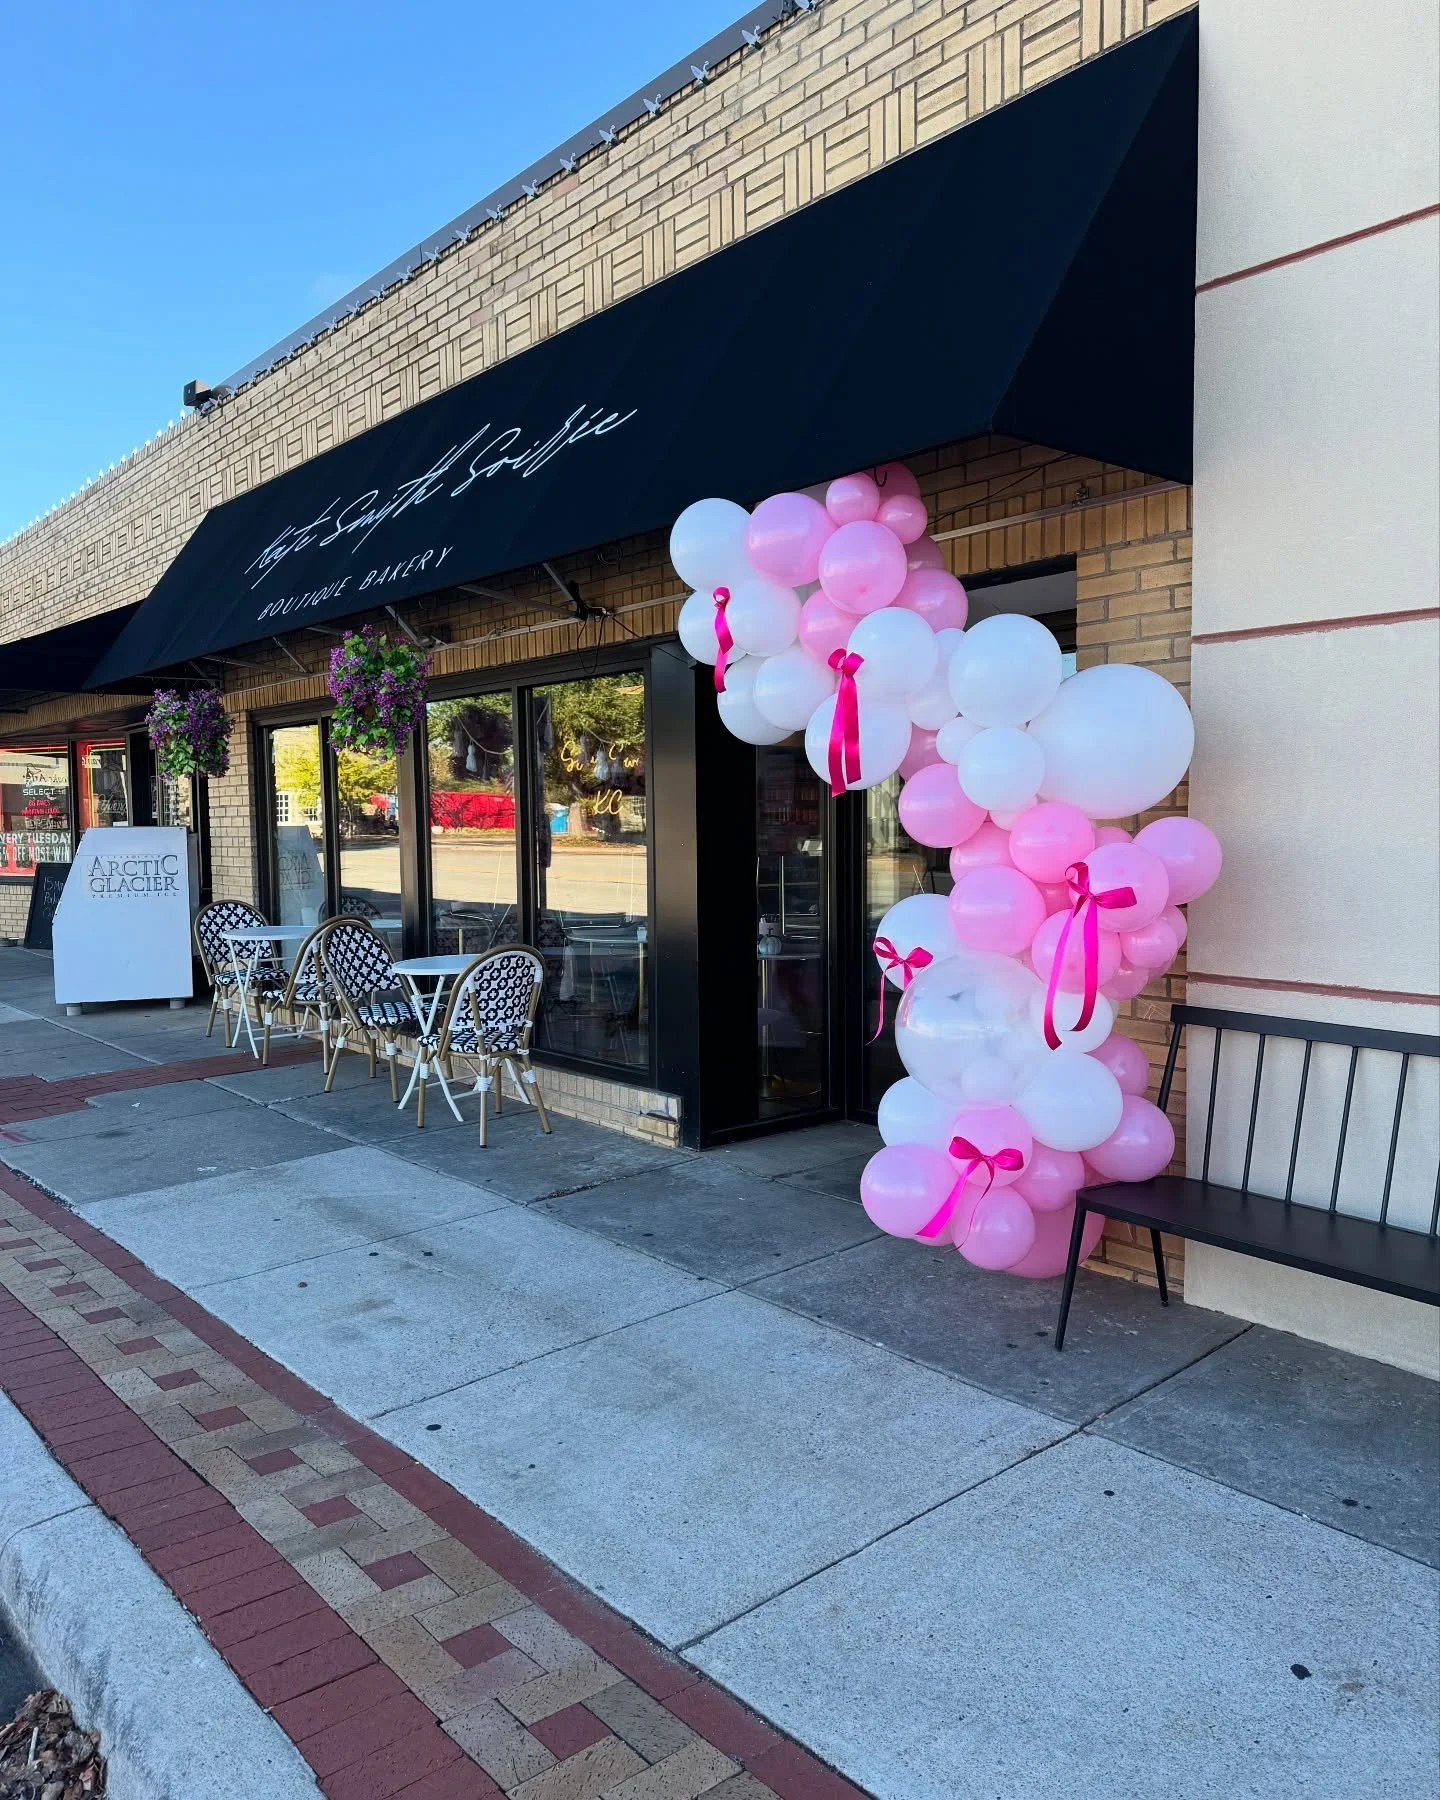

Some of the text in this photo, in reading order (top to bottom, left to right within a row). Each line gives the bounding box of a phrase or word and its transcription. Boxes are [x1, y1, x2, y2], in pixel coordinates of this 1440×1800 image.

[319, 423, 491, 554] Smith
[257, 546, 454, 621] BOUTIQUE BAKERY
[22, 788, 55, 796] SELECT
[27, 832, 71, 844] TUESDAY
[29, 846, 50, 861] MOST
[88, 854, 179, 876] ARCTIC
[90, 877, 179, 892] GLACIER
